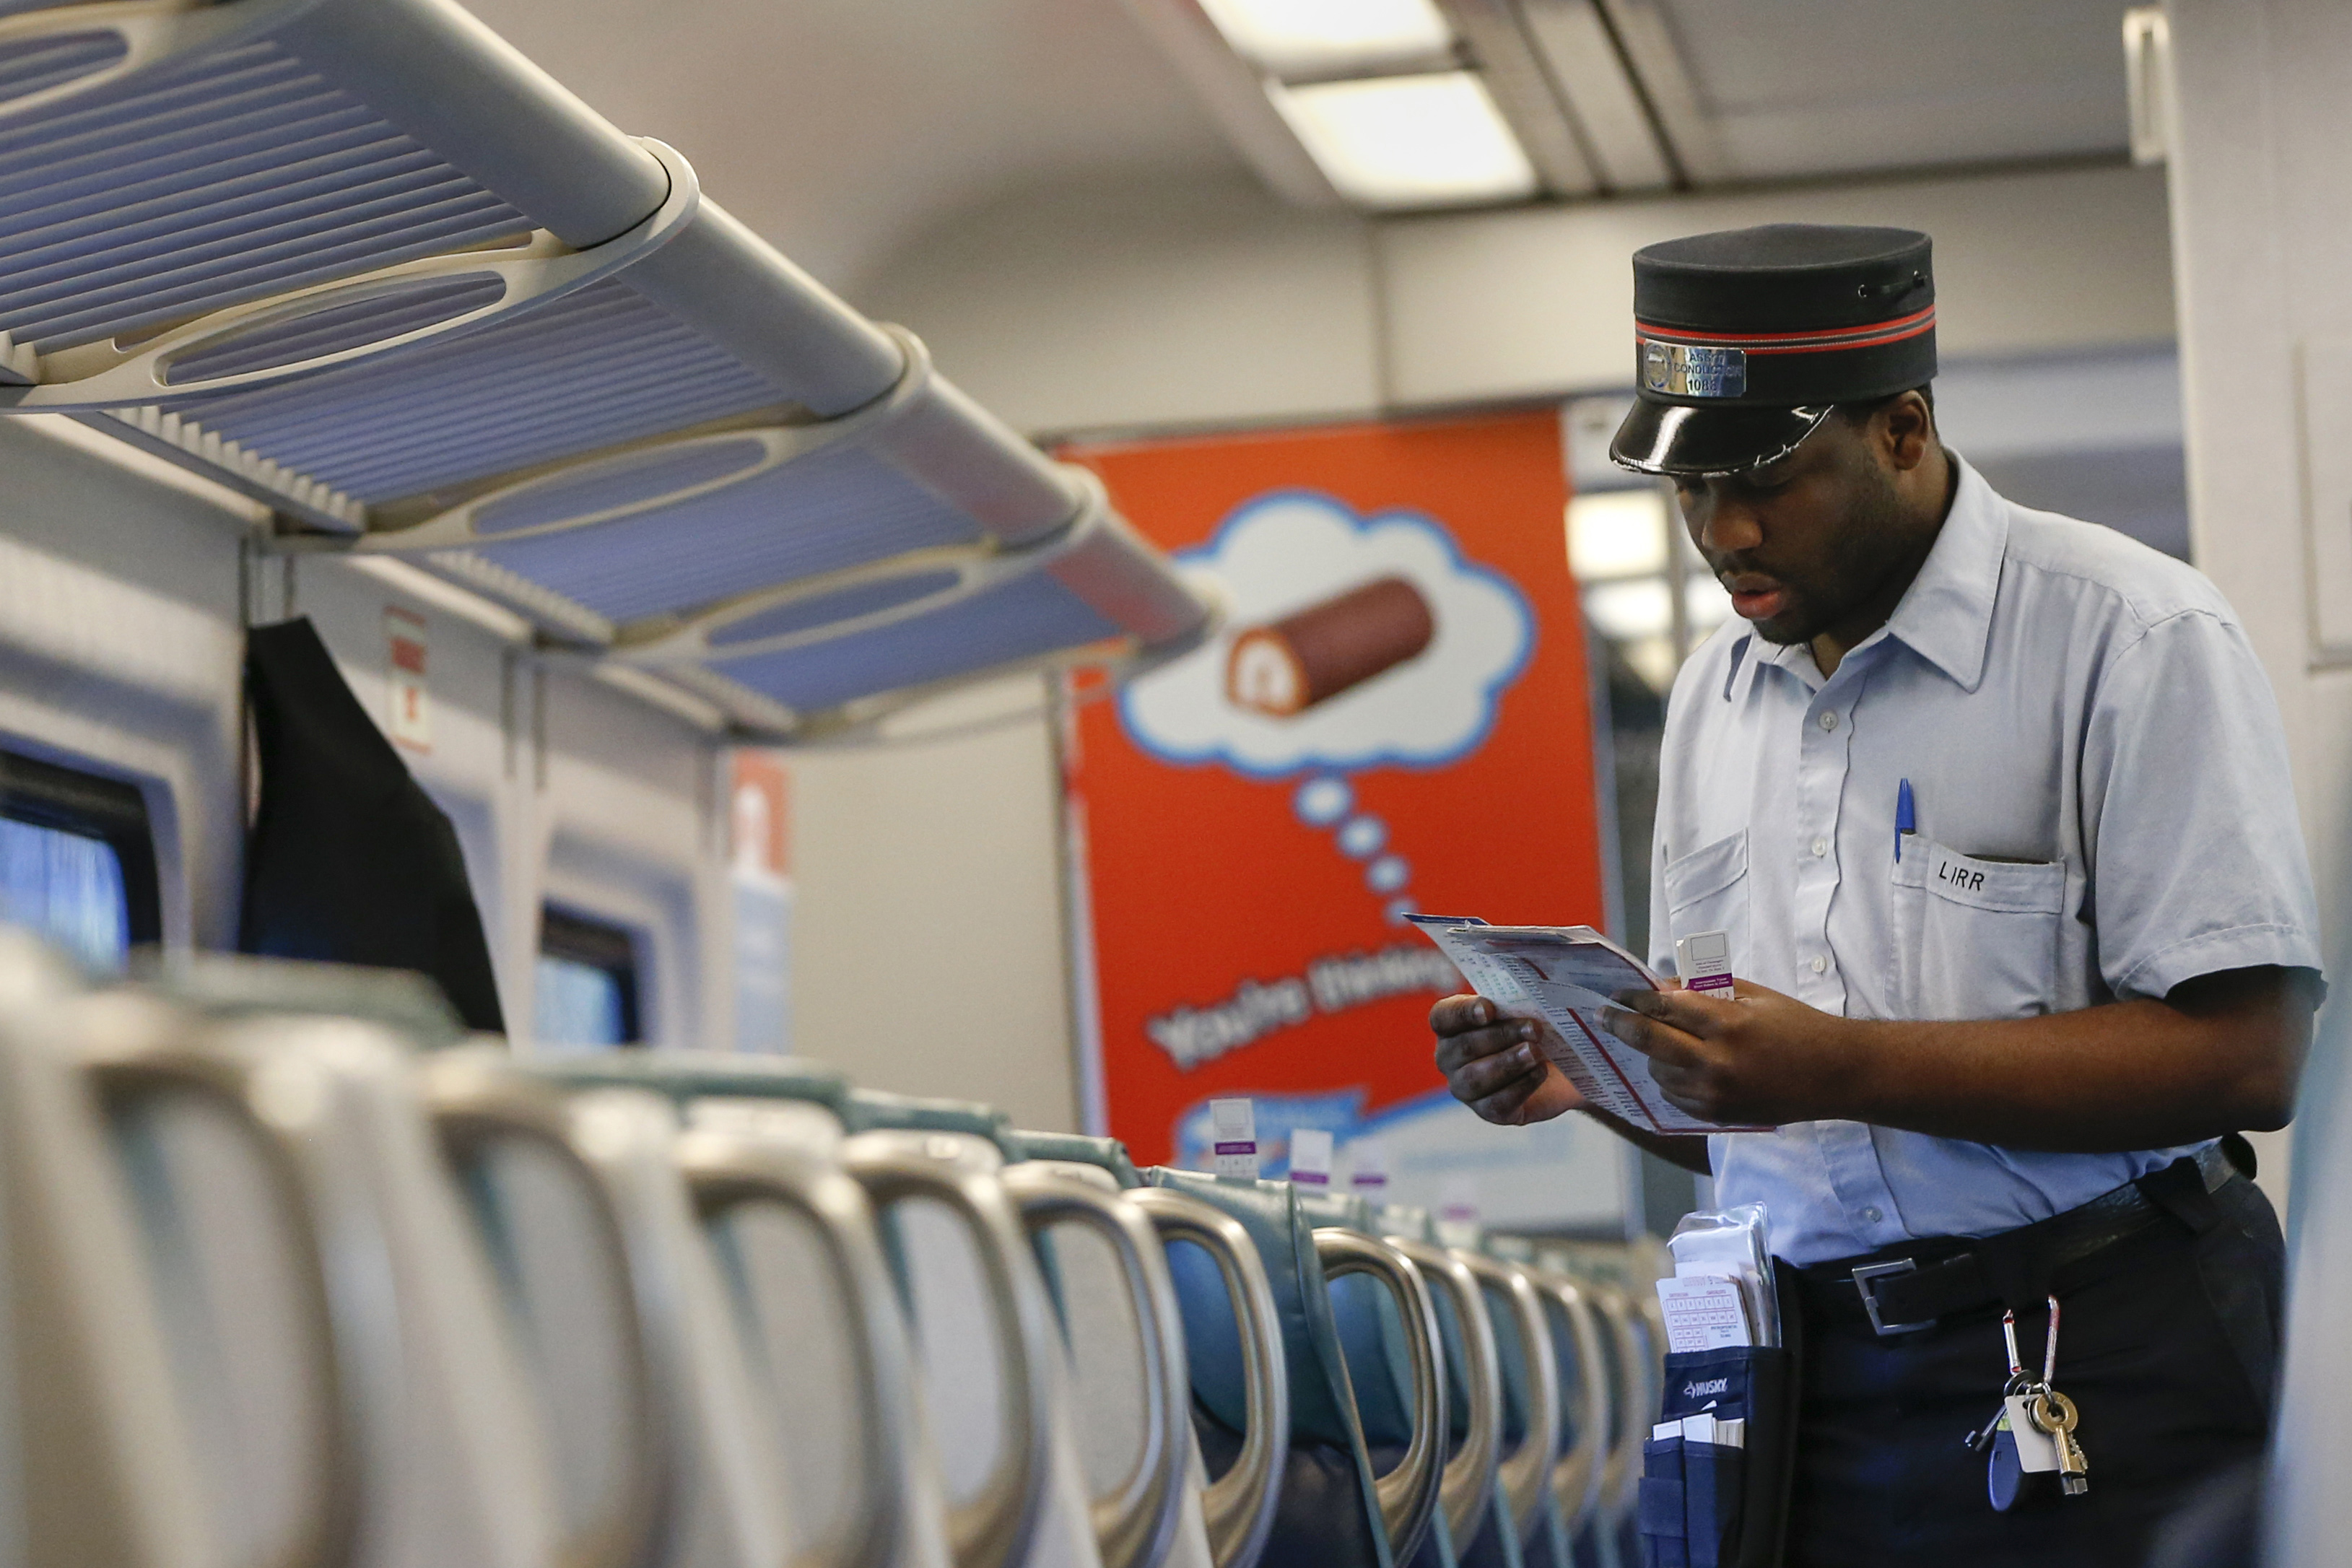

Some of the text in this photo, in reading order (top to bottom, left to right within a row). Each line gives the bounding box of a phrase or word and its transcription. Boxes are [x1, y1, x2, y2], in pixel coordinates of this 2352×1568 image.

[1674, 362, 1743, 377] CONDUCTOR
[1939, 861, 1985, 892] LIRR
[1696, 1377, 1728, 1396] HUSKY
